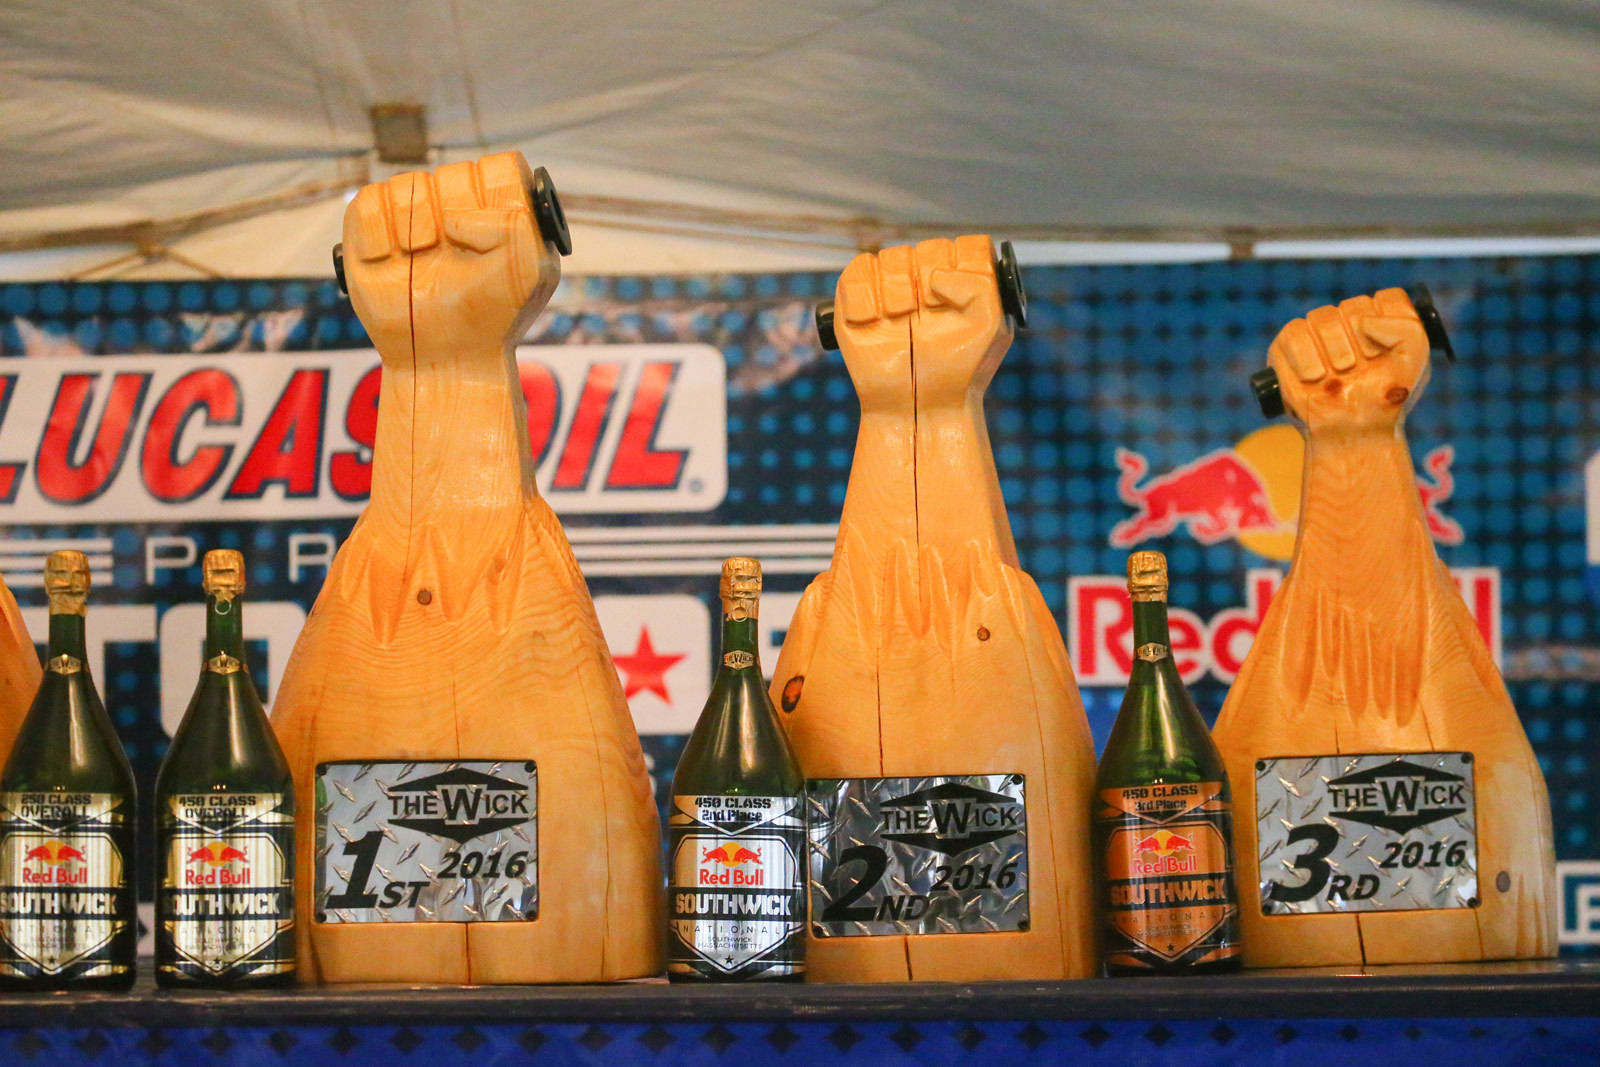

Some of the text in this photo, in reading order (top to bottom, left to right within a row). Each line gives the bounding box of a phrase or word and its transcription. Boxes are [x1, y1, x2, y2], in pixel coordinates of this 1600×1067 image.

[0, 364, 382, 505] UCAS
[48, 794, 92, 805] CLASS
[179, 796, 257, 807] 450 CLASS
[1122, 784, 1199, 800] 450 CLASS
[1328, 780, 1467, 813] THE WICK
[21, 805, 90, 819] OVERALL
[185, 807, 249, 819] OVERALL
[388, 788, 529, 822] THE WICK
[695, 797, 772, 809] 450 CLASS
[1135, 799, 1187, 812] 3rd Place
[701, 809, 763, 821] 2nd Place
[880, 802, 1018, 835] THE WICK
[437, 850, 530, 880] 2016
[1133, 855, 1198, 875] Red Bull
[1270, 822, 1381, 903] 3RD
[1379, 840, 1468, 869] 2016
[22, 867, 88, 884] Red Bull
[185, 868, 251, 886] Red Bull
[325, 830, 431, 910] 1ST
[699, 868, 764, 886] Red Bull
[930, 862, 1019, 892] 2016
[821, 844, 931, 923] 2ND
[1112, 878, 1227, 905] SOUTHWICK
[165, 893, 280, 916] OUTHWICK
[676, 893, 791, 916] SOUTHWICK
[683, 925, 780, 935] NATIONAL
